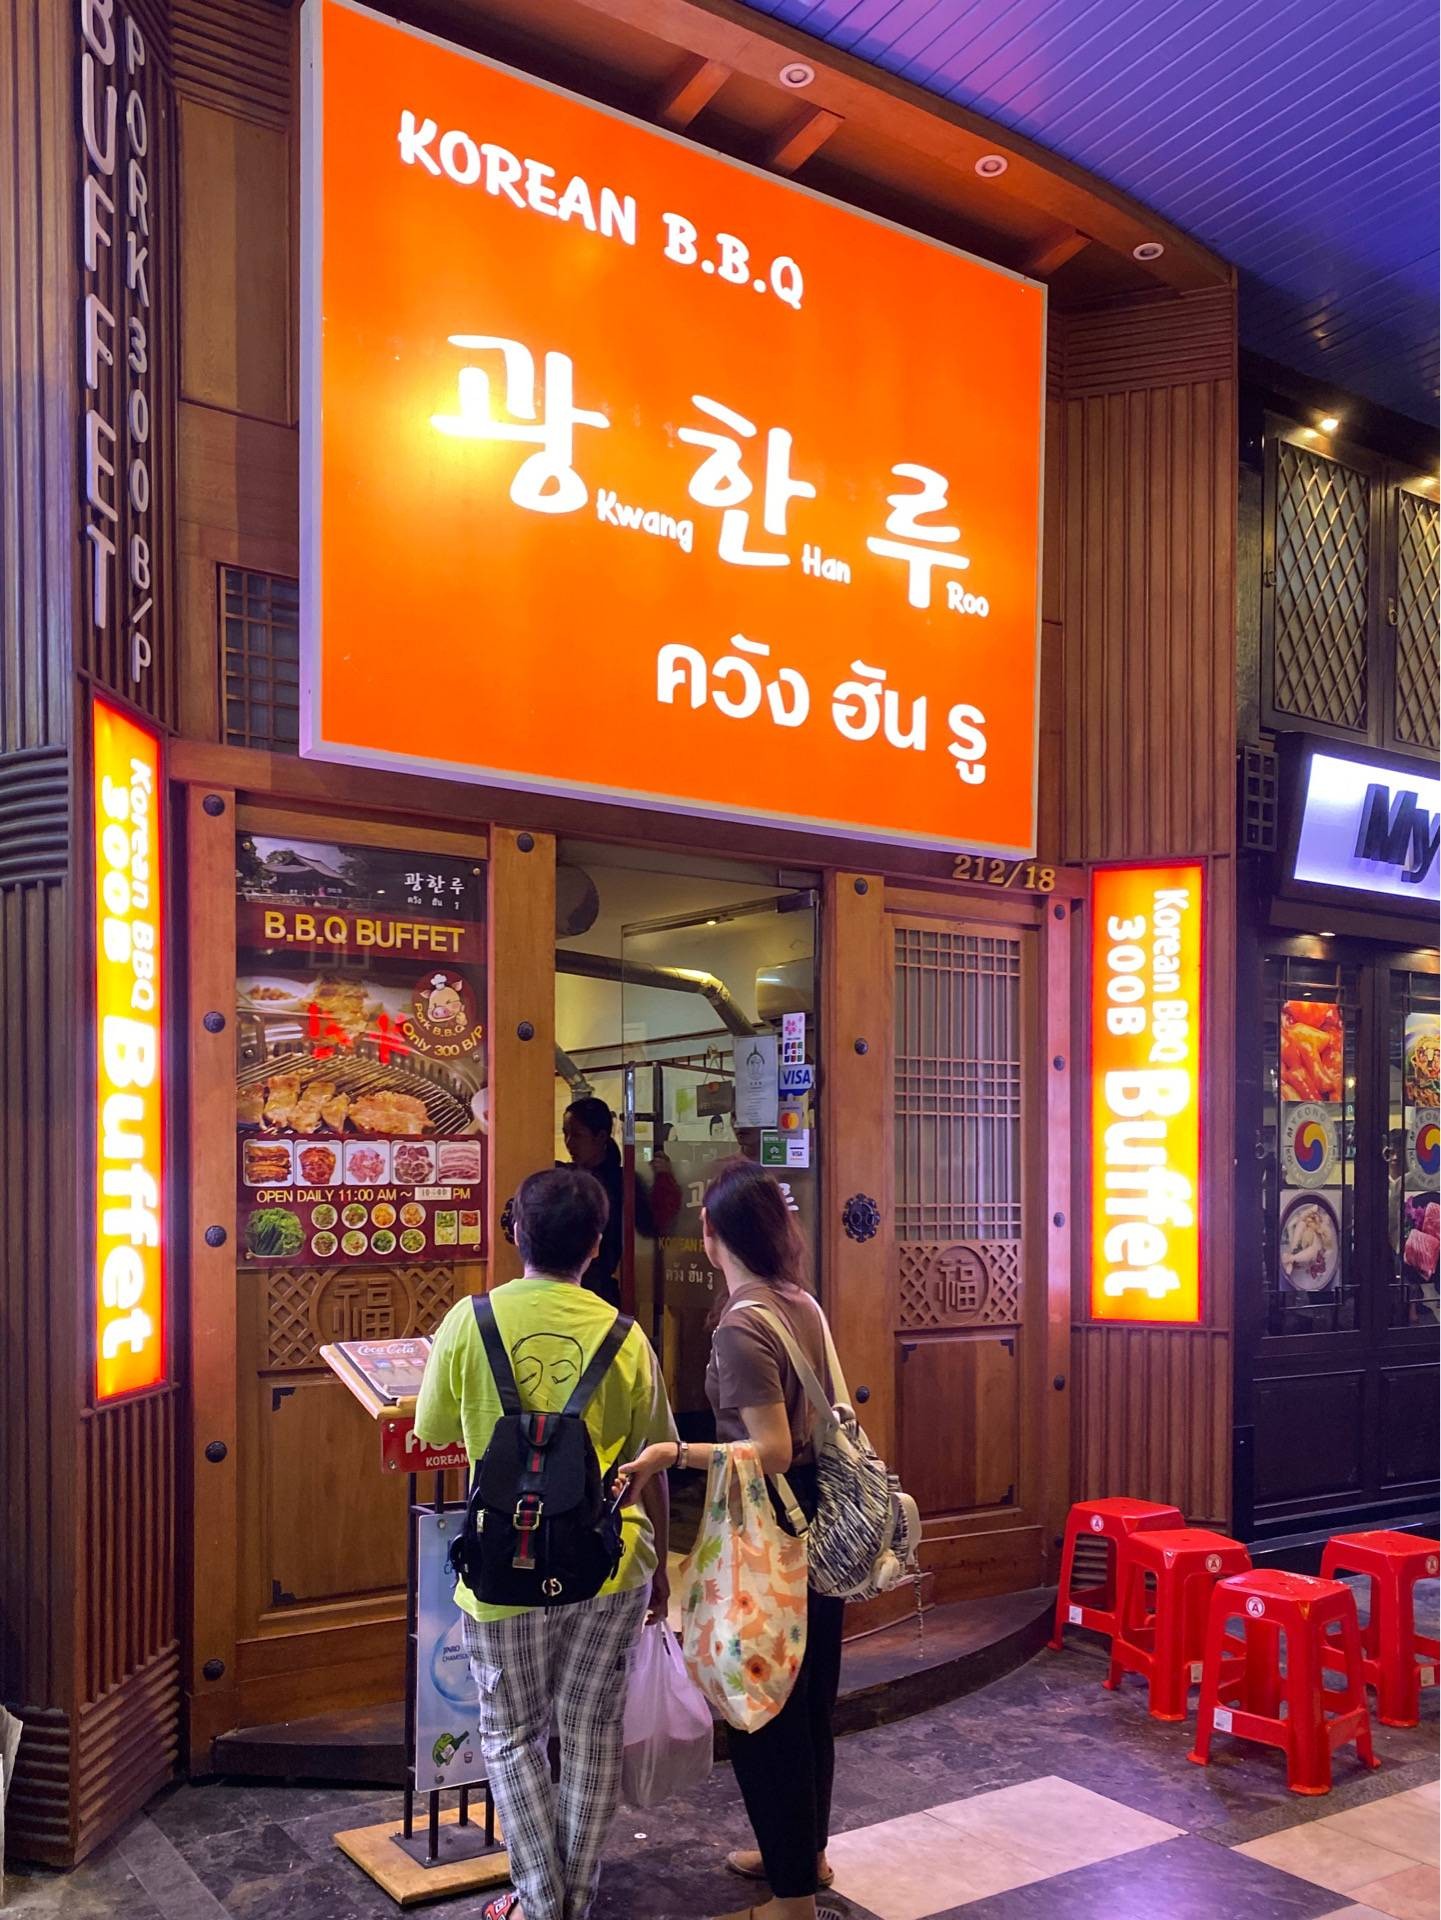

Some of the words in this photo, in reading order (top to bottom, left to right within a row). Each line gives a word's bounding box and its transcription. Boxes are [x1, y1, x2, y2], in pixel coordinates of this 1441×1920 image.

[398, 109, 638, 246] KOREAN
[662, 211, 805, 310] B.B.Q
[430, 334, 611, 515] 광
[677, 394, 818, 567] 한
[866, 462, 970, 609] 루
[596, 488, 694, 553] Kwang
[802, 544, 852, 584] Han
[946, 581, 991, 618] Roo
[656, 633, 811, 728] ควัง
[831, 659, 928, 752] ฮัน
[946, 703, 988, 786] รู
[129, 758, 153, 910] Korean
[952, 854, 1056, 892] 212/18
[131, 919, 156, 1012] BBQ
[264, 911, 348, 945] B.B.Q
[355, 918, 466, 953] BUFFET
[1106, 914, 1146, 1036] 300B
[1152, 888, 1190, 993] Korean
[402, 1022, 432, 1052] Only
[434, 1044, 460, 1056] 300
[461, 1025, 483, 1051] B/P
[414, 1003, 432, 1031] Pork
[1149, 1000, 1189, 1063] BBQ
[783, 1069, 811, 1085] VISA
[102, 1014, 160, 1360] Buffet
[256, 1190, 293, 1203] OPEN
[297, 1189, 335, 1202] DAILY
[338, 1189, 374, 1202] 11:00
[377, 1188, 397, 1201] AM
[452, 1187, 471, 1200] PM
[1104, 1068, 1193, 1300] Buffet
[425, 1454, 468, 1467] KOREAN
